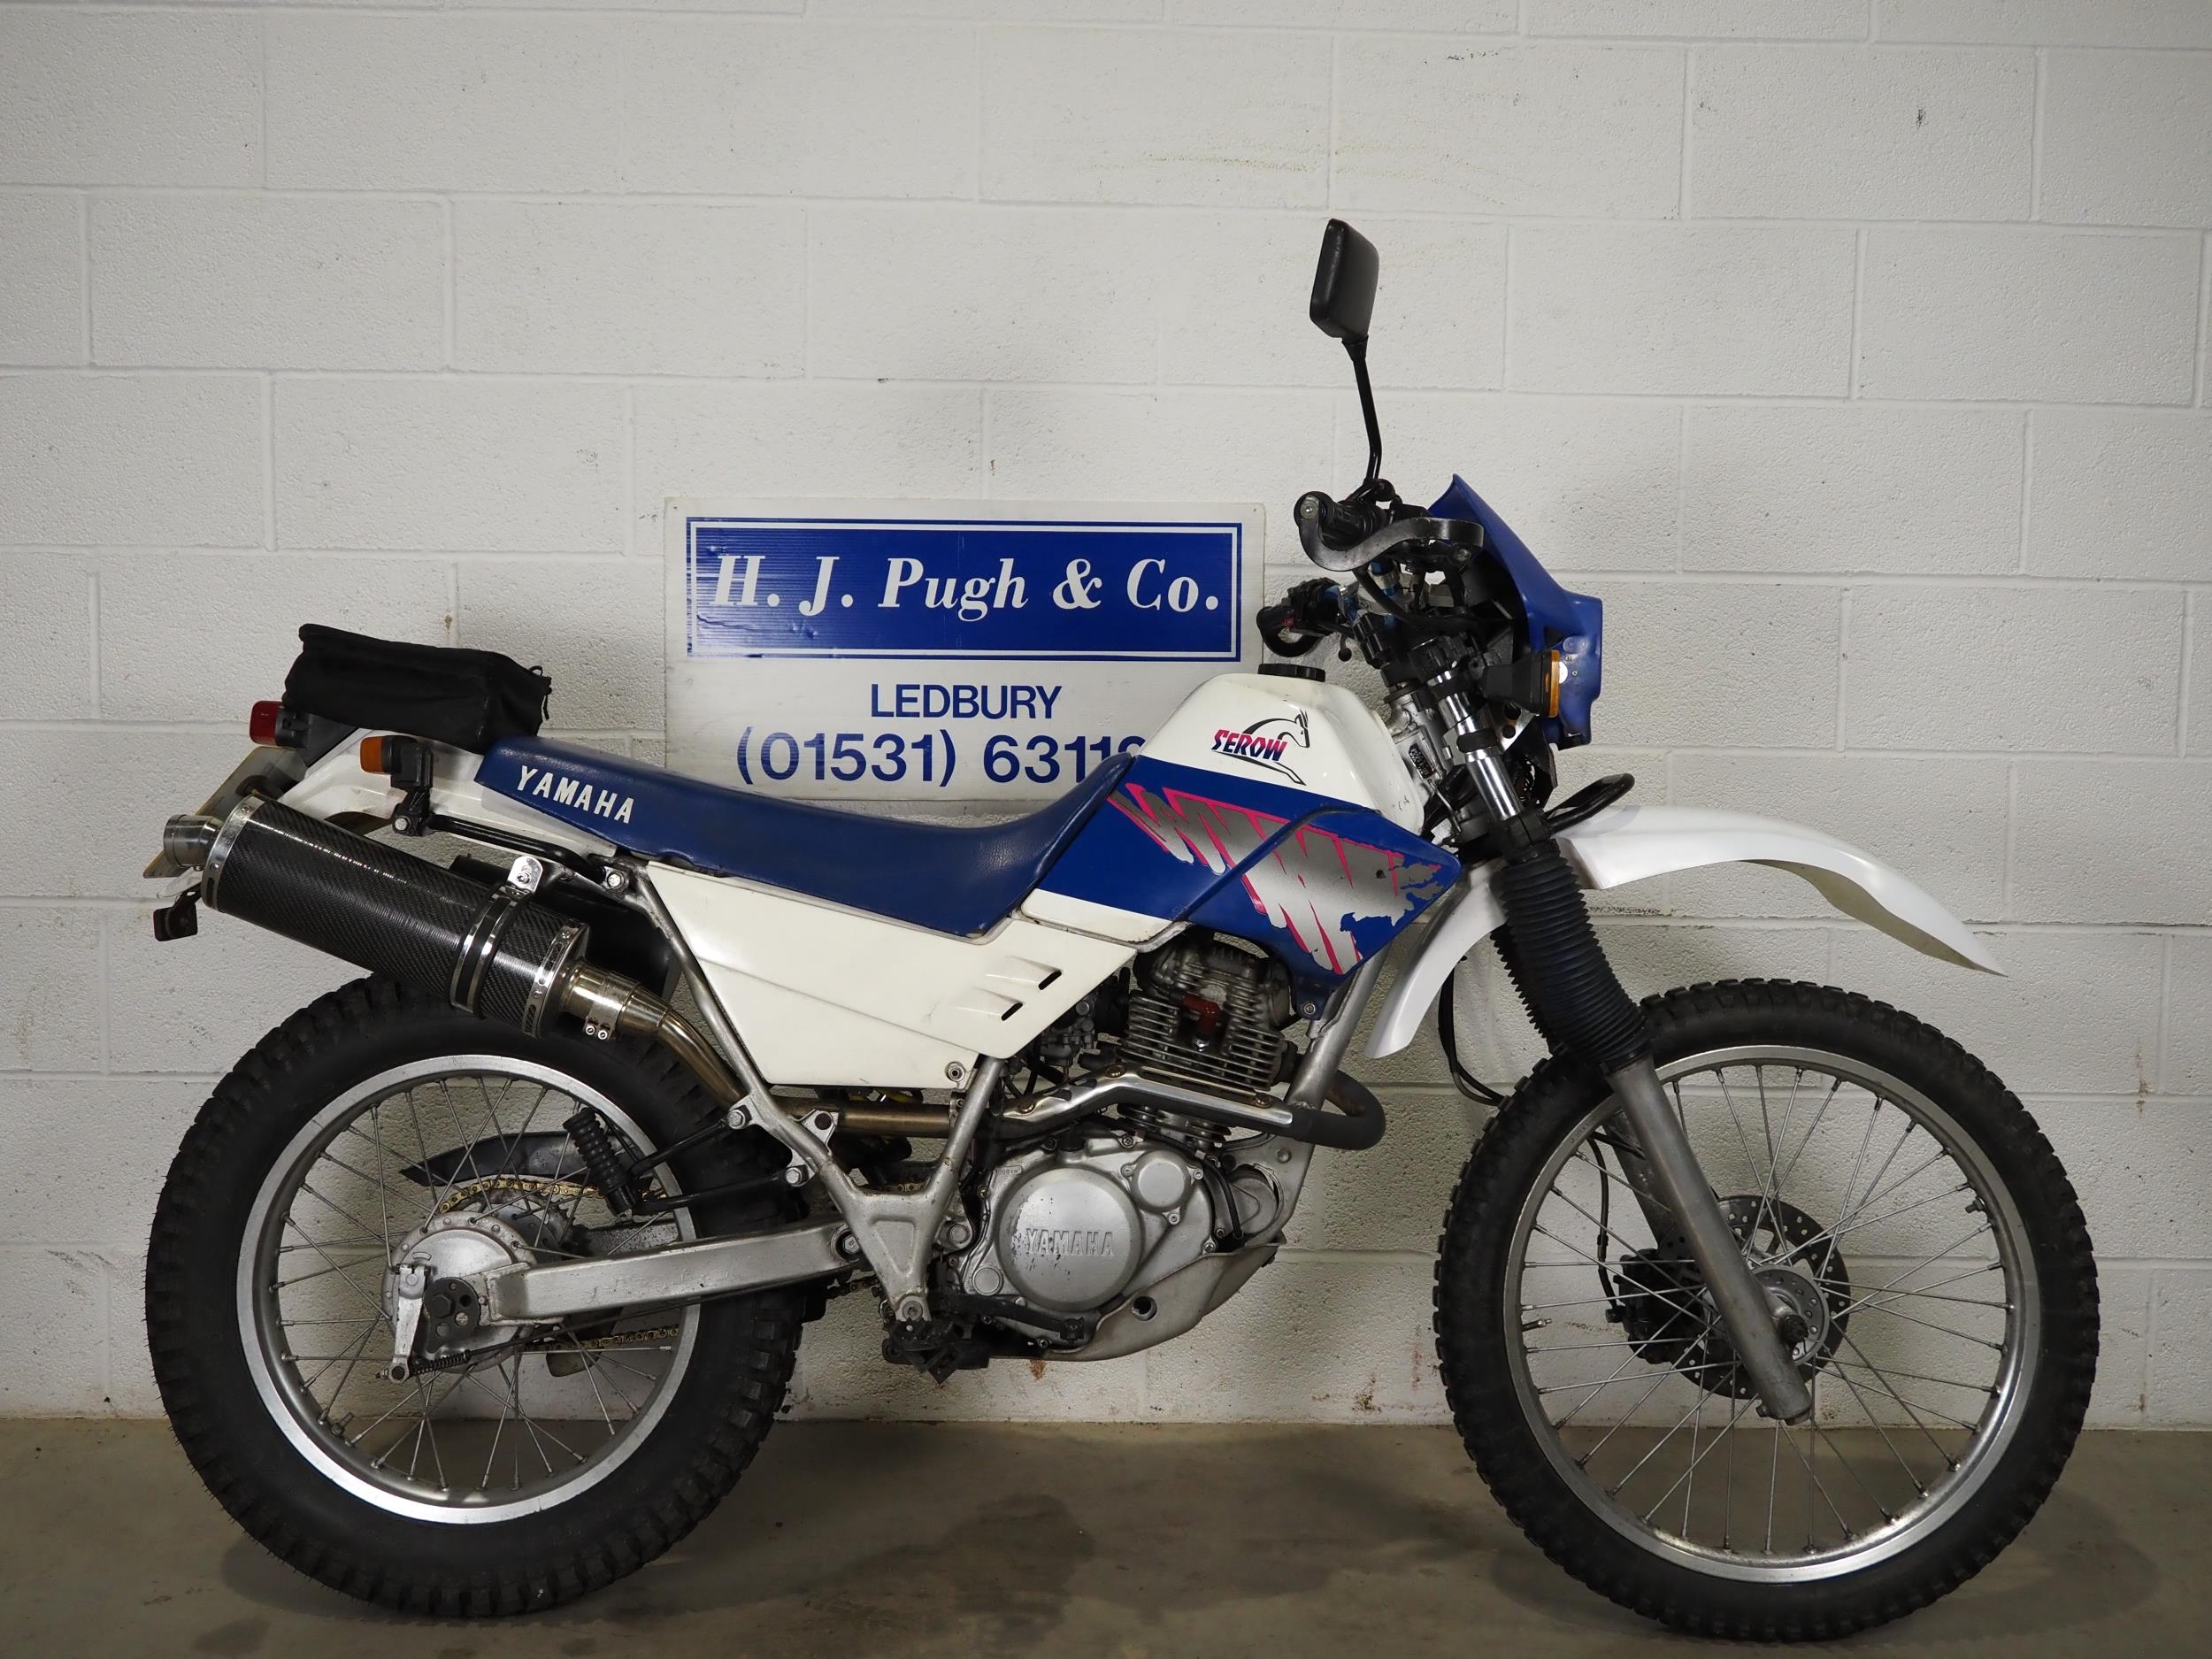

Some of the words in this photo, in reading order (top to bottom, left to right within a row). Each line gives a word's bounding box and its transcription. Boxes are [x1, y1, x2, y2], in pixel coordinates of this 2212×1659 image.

[709, 555, 780, 607] H.
[798, 556, 854, 617] J.
[877, 557, 1029, 622] Pugh
[1052, 558, 1102, 610] &
[1126, 558, 1219, 612] Co.
[871, 684, 1063, 719] LEDBURY
[736, 727, 957, 787] (01531)
[1210, 729, 1288, 762] SEROW
[517, 764, 635, 824] YAMAHA
[1026, 1227, 1115, 1256] YAMAHA
